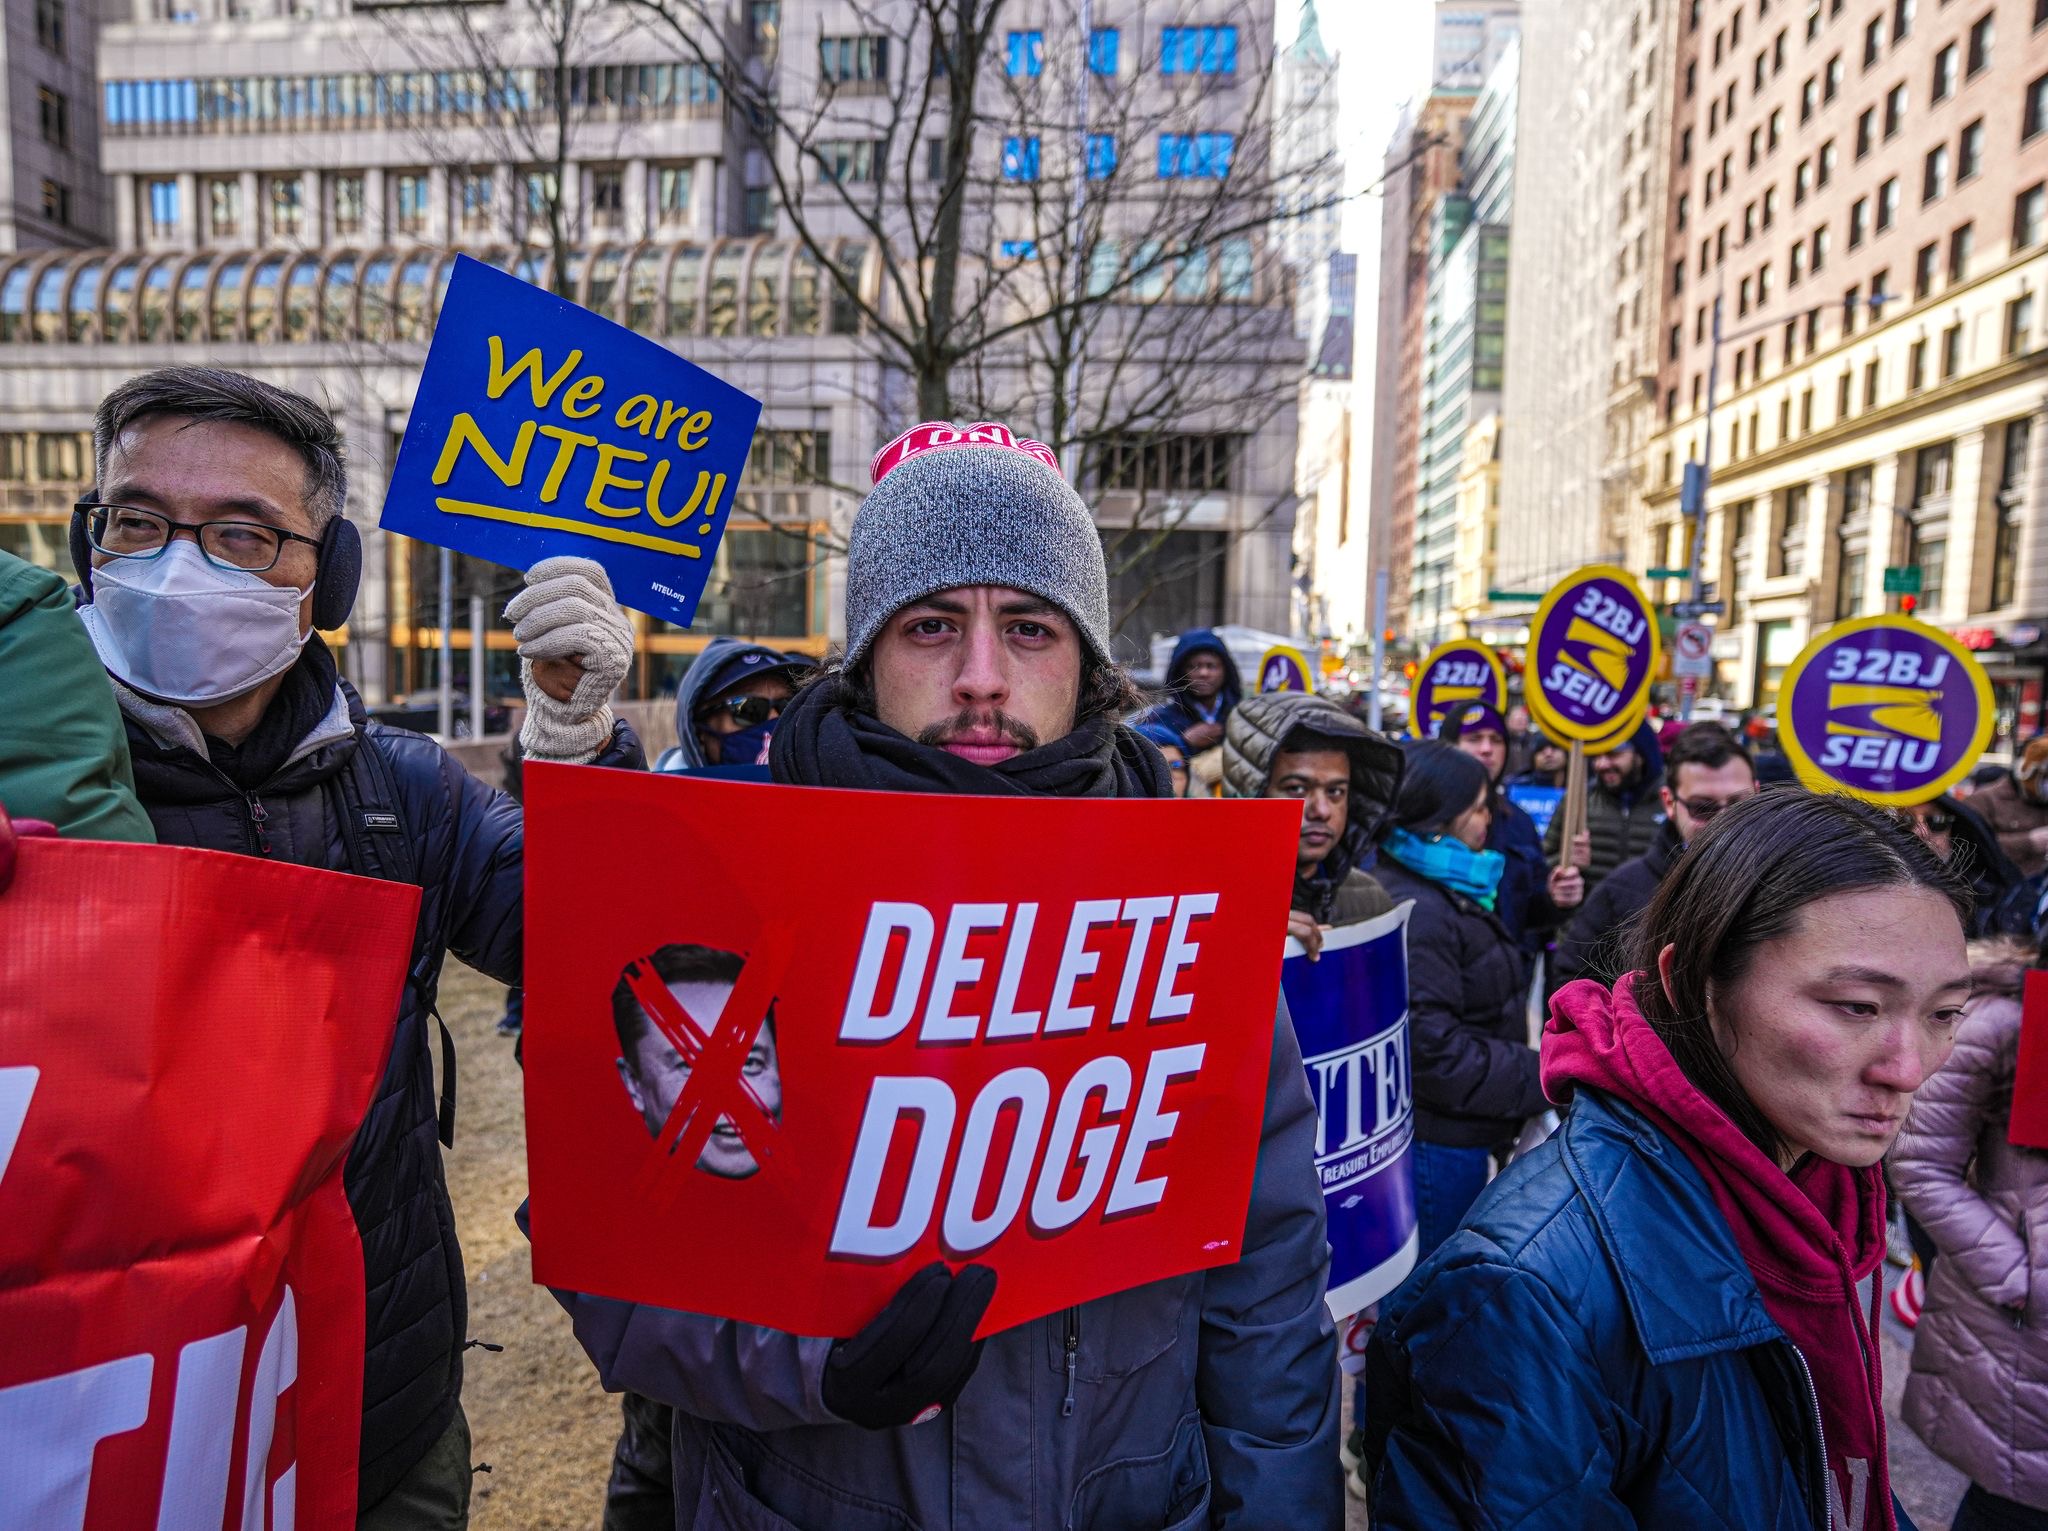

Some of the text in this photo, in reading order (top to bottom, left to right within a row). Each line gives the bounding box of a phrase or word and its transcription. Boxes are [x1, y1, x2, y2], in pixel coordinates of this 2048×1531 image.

[486, 335, 713, 451] We are
[431, 412, 727, 535] NTEU!
[651, 581, 685, 603] NTEU.org
[1573, 586, 1647, 645] 32BJ
[1431, 661, 1491, 686] 32BJ
[1543, 663, 1620, 715] SEIU
[1826, 647, 1950, 687] 32BJ
[1819, 735, 1941, 773] SEIU
[838, 893, 1220, 1043] DELETE
[829, 1043, 1207, 1258] DOGE
[1316, 1153, 1369, 1184] TREASURY
